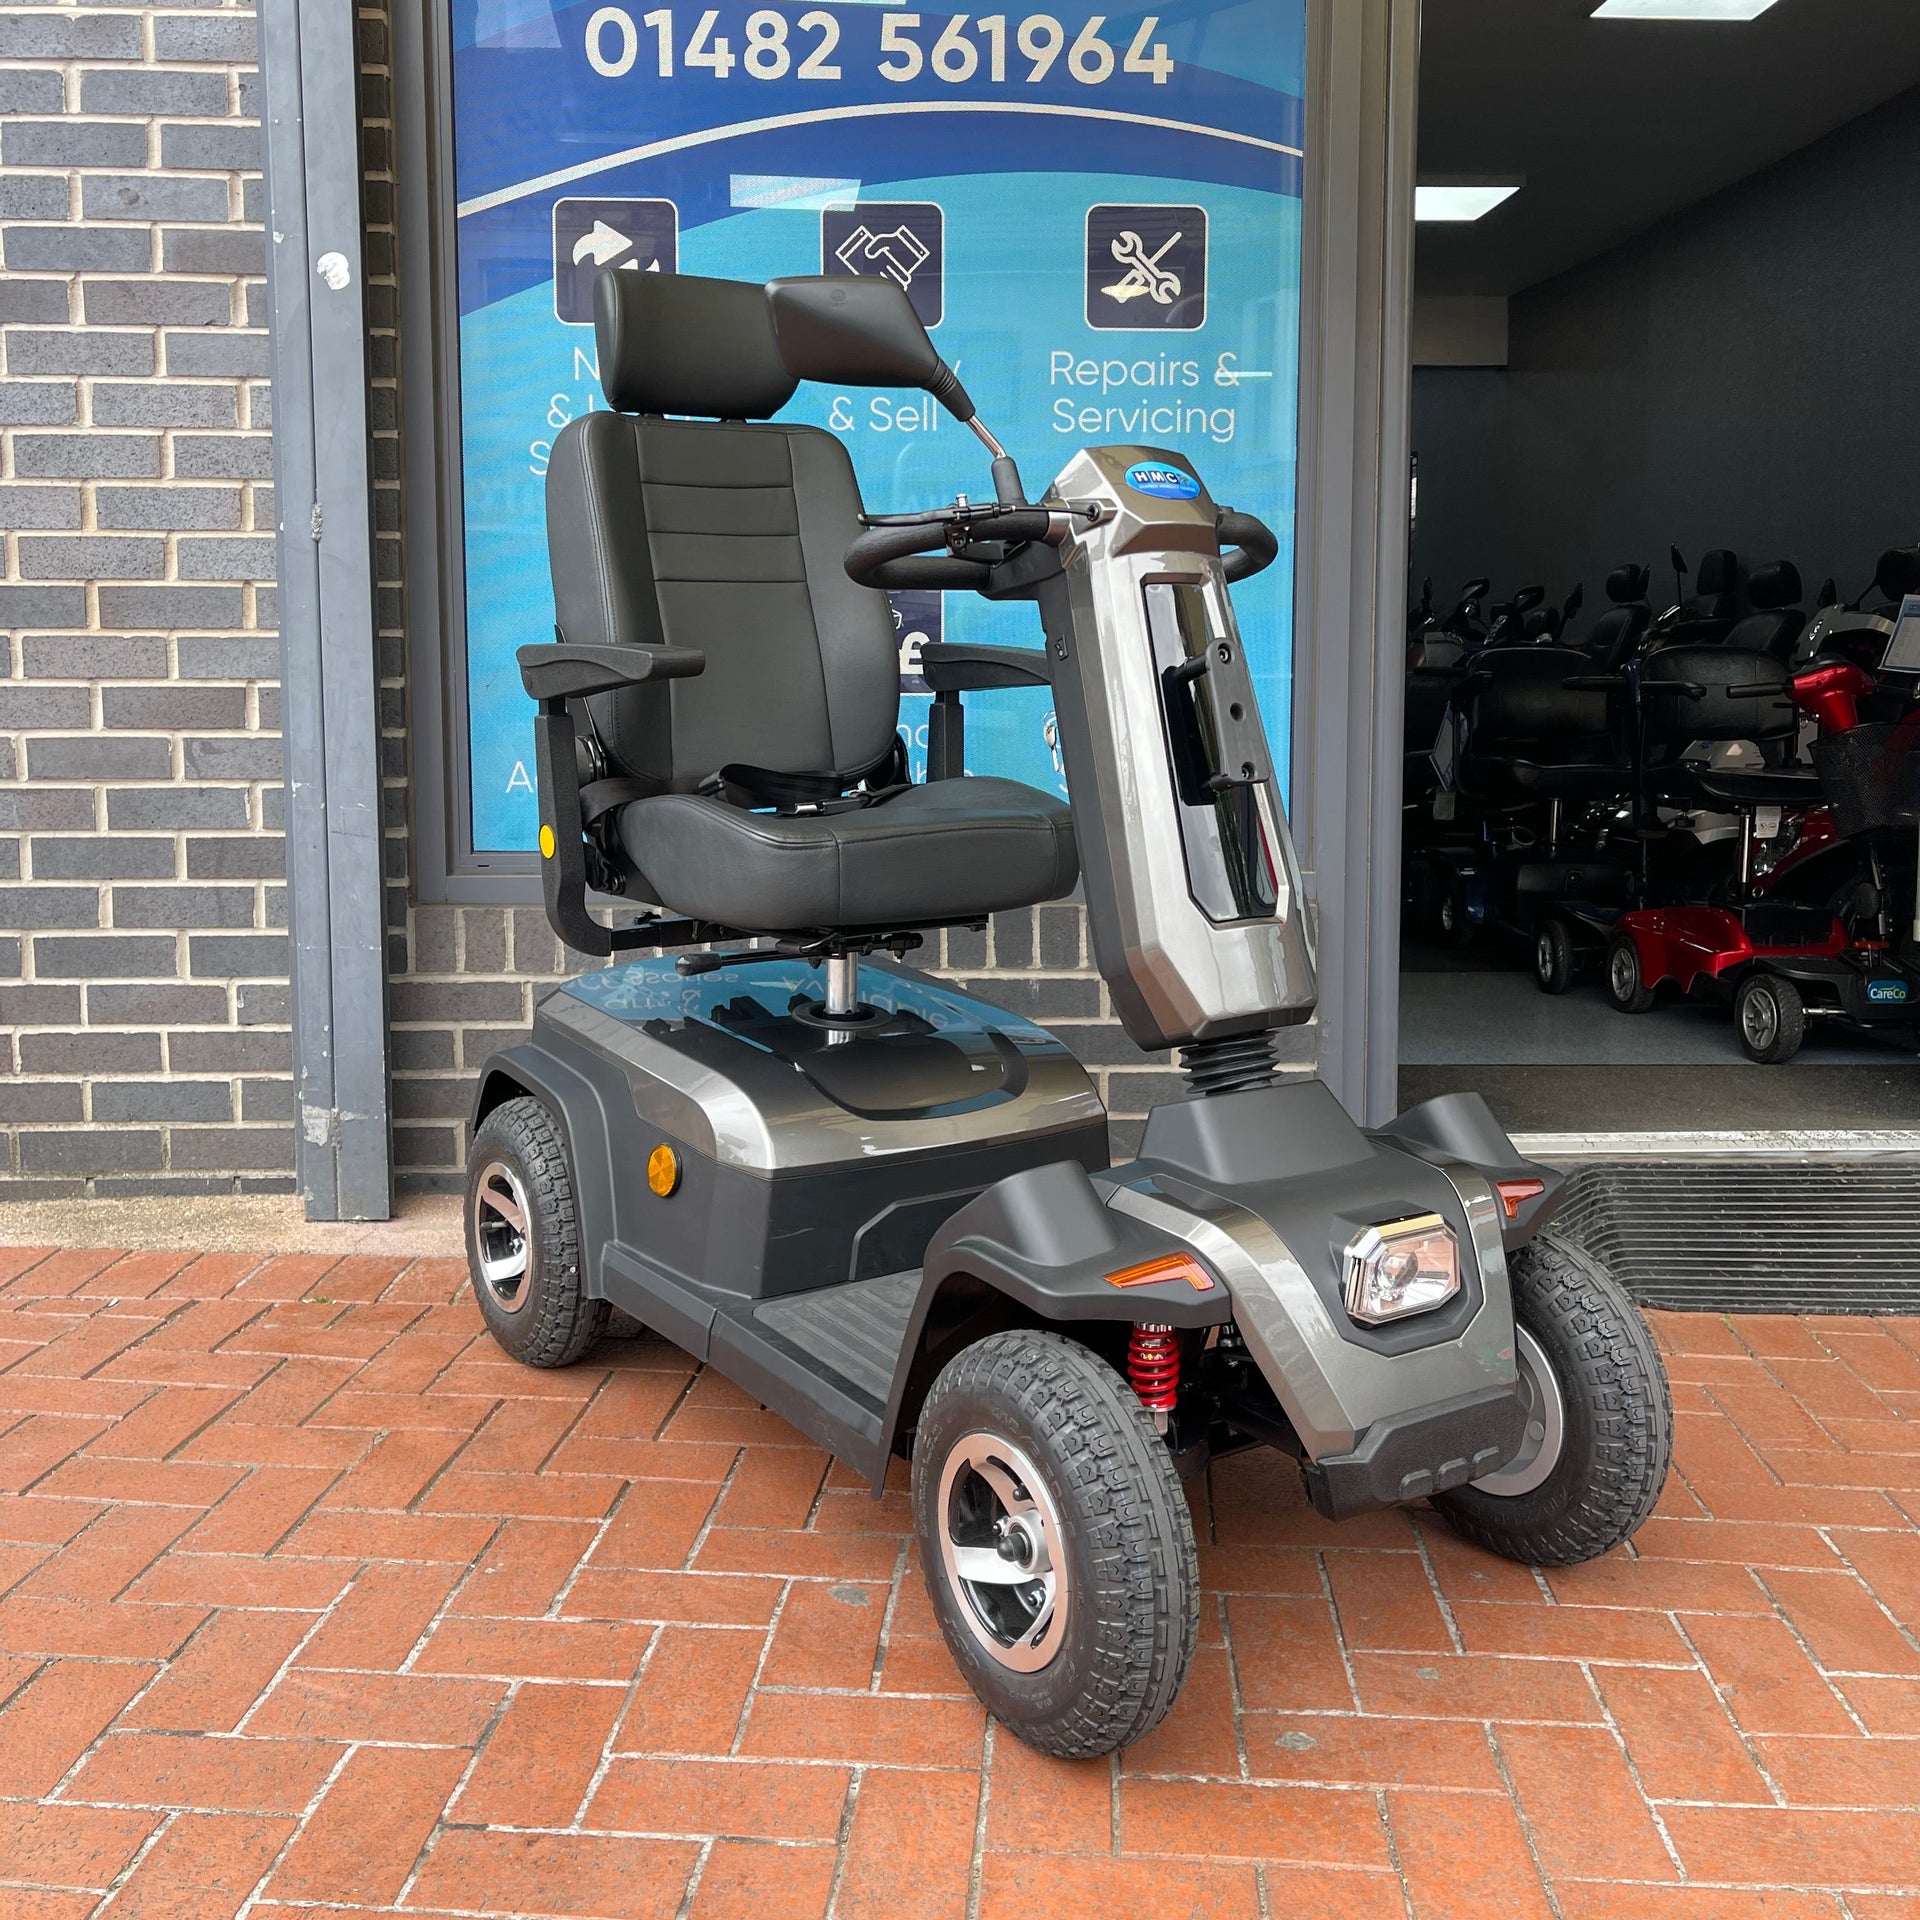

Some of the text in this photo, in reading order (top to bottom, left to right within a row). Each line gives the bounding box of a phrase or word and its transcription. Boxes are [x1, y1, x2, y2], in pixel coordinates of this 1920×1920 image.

[584, 8, 1174, 84] 01482 561964
[1050, 350, 1240, 394] Repairs &
[547, 393, 572, 428] &
[828, 396, 937, 432] & Sell
[1052, 398, 1235, 443] Servicing
[1134, 472, 1177, 482] HMC
[1870, 988, 1906, 999] CareCo
